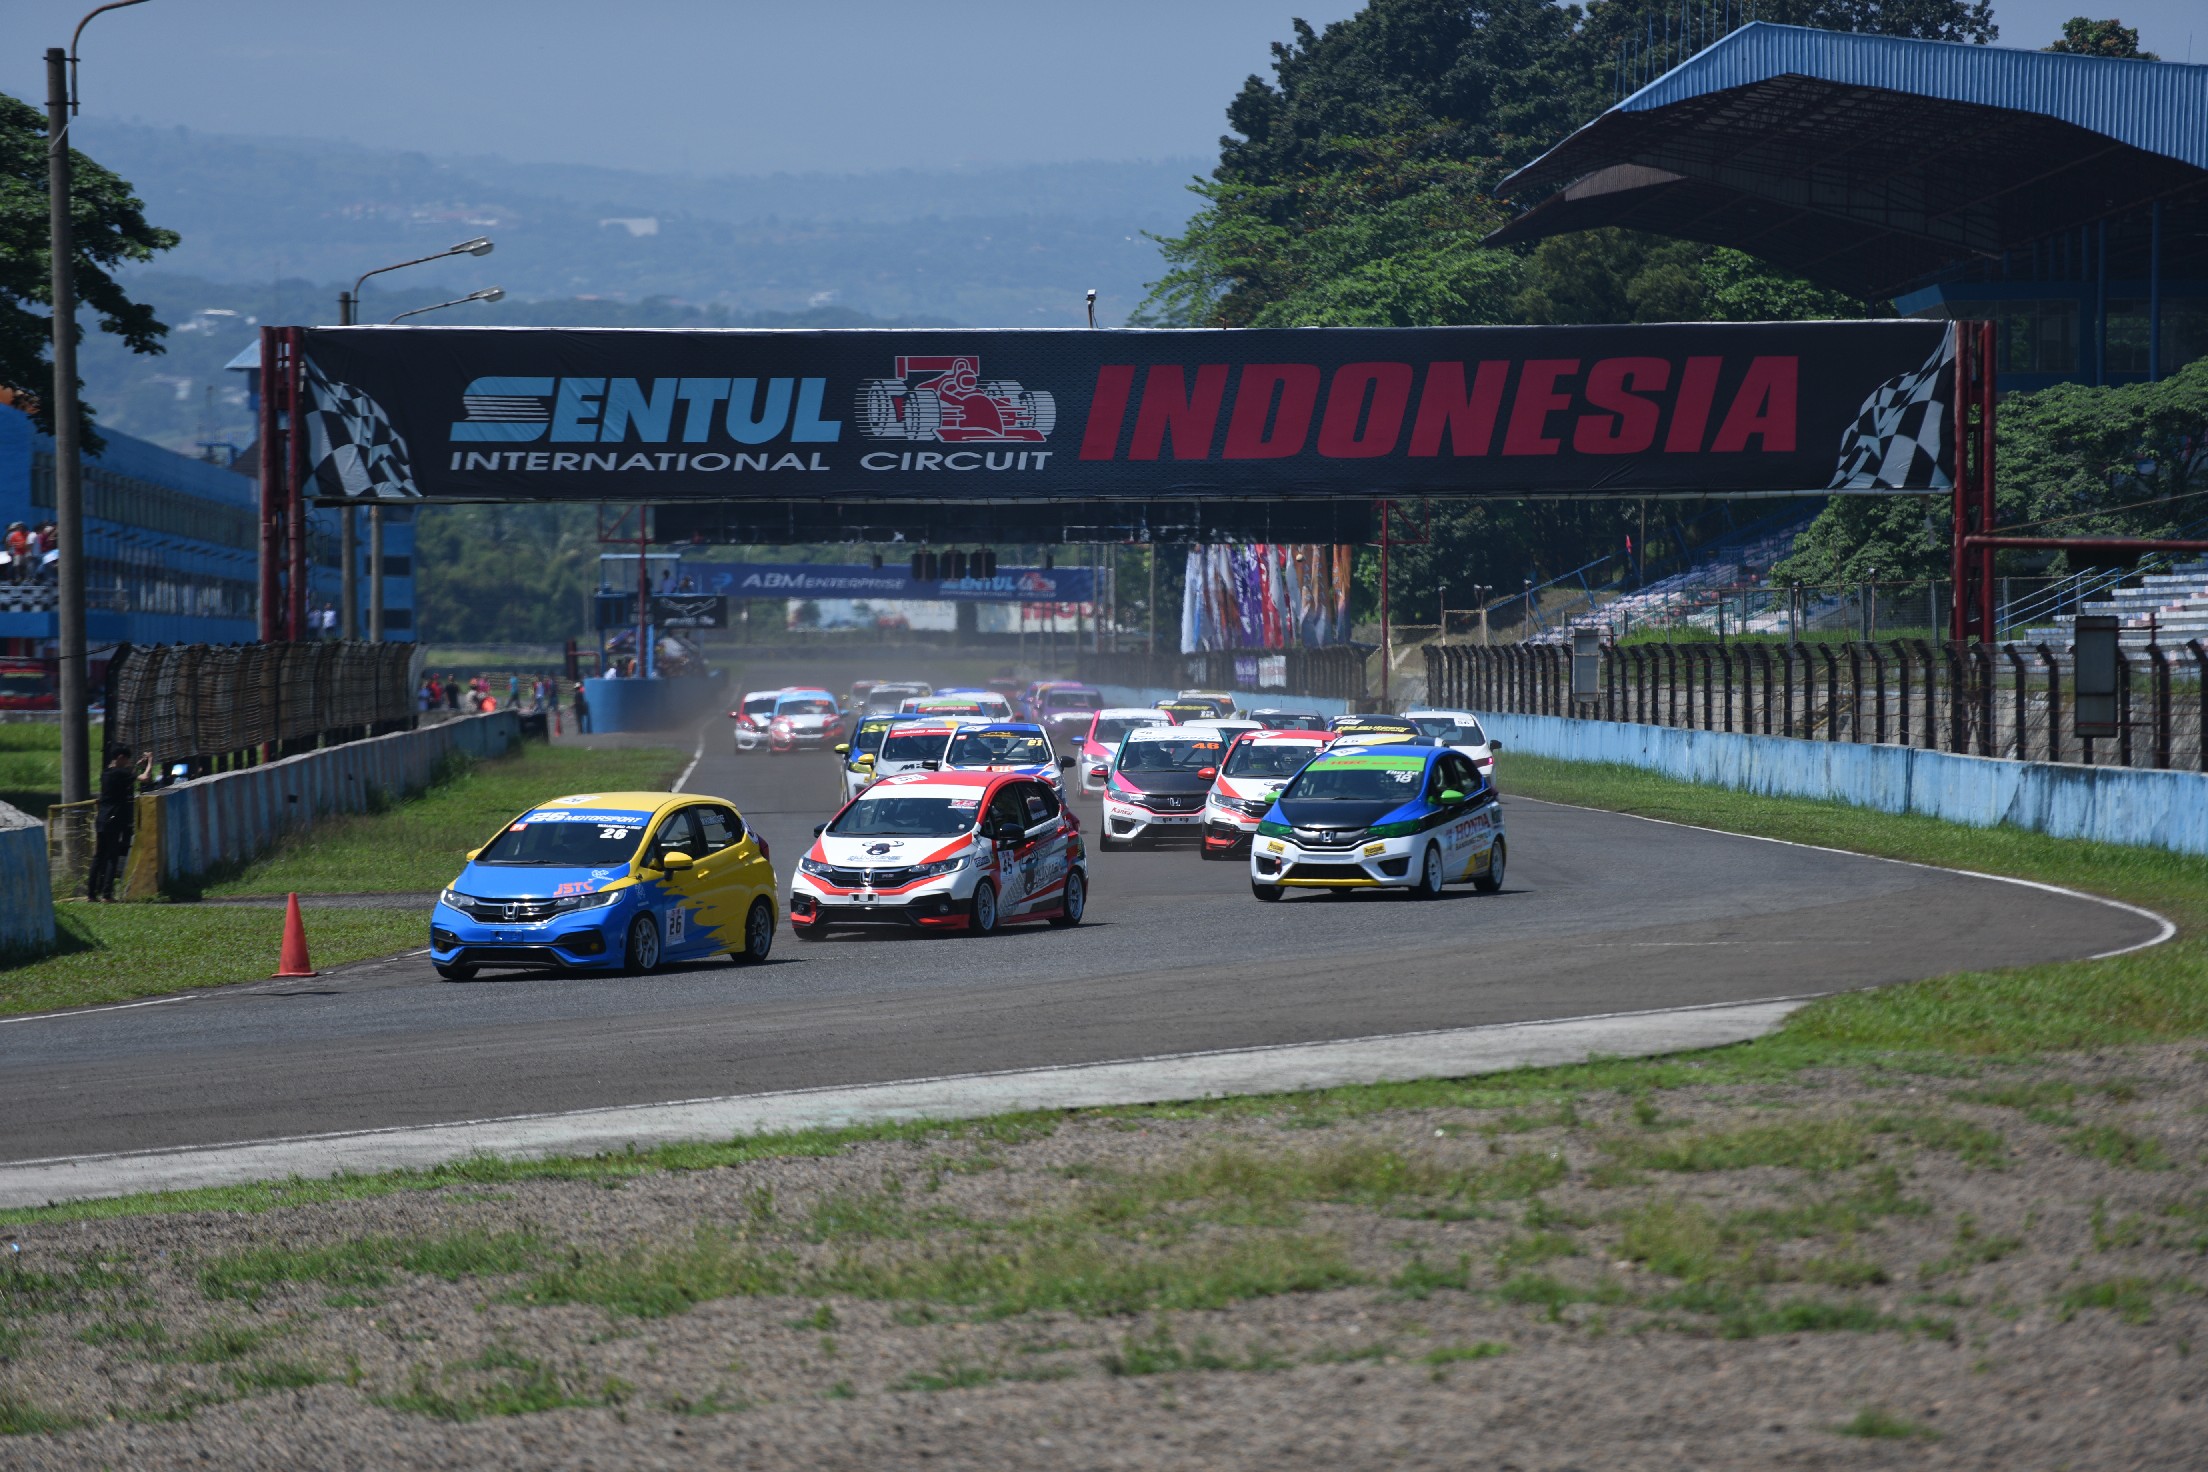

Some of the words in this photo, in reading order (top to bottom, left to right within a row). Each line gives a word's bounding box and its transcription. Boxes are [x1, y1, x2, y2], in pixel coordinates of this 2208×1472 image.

[450, 376, 841, 444] SENTUL
[1079, 355, 1799, 461] INDONESIA
[450, 451, 830, 472] INTERNATIONAL
[859, 451, 1055, 471] CIRCUIT
[742, 572, 805, 589] ABM
[1394, 774, 1413, 784] 18
[524, 811, 570, 823] 26
[564, 815, 643, 823] MOTORSPORT
[1456, 813, 1490, 841] HONDA
[600, 828, 628, 839] 26
[669, 915, 682, 935] 26
